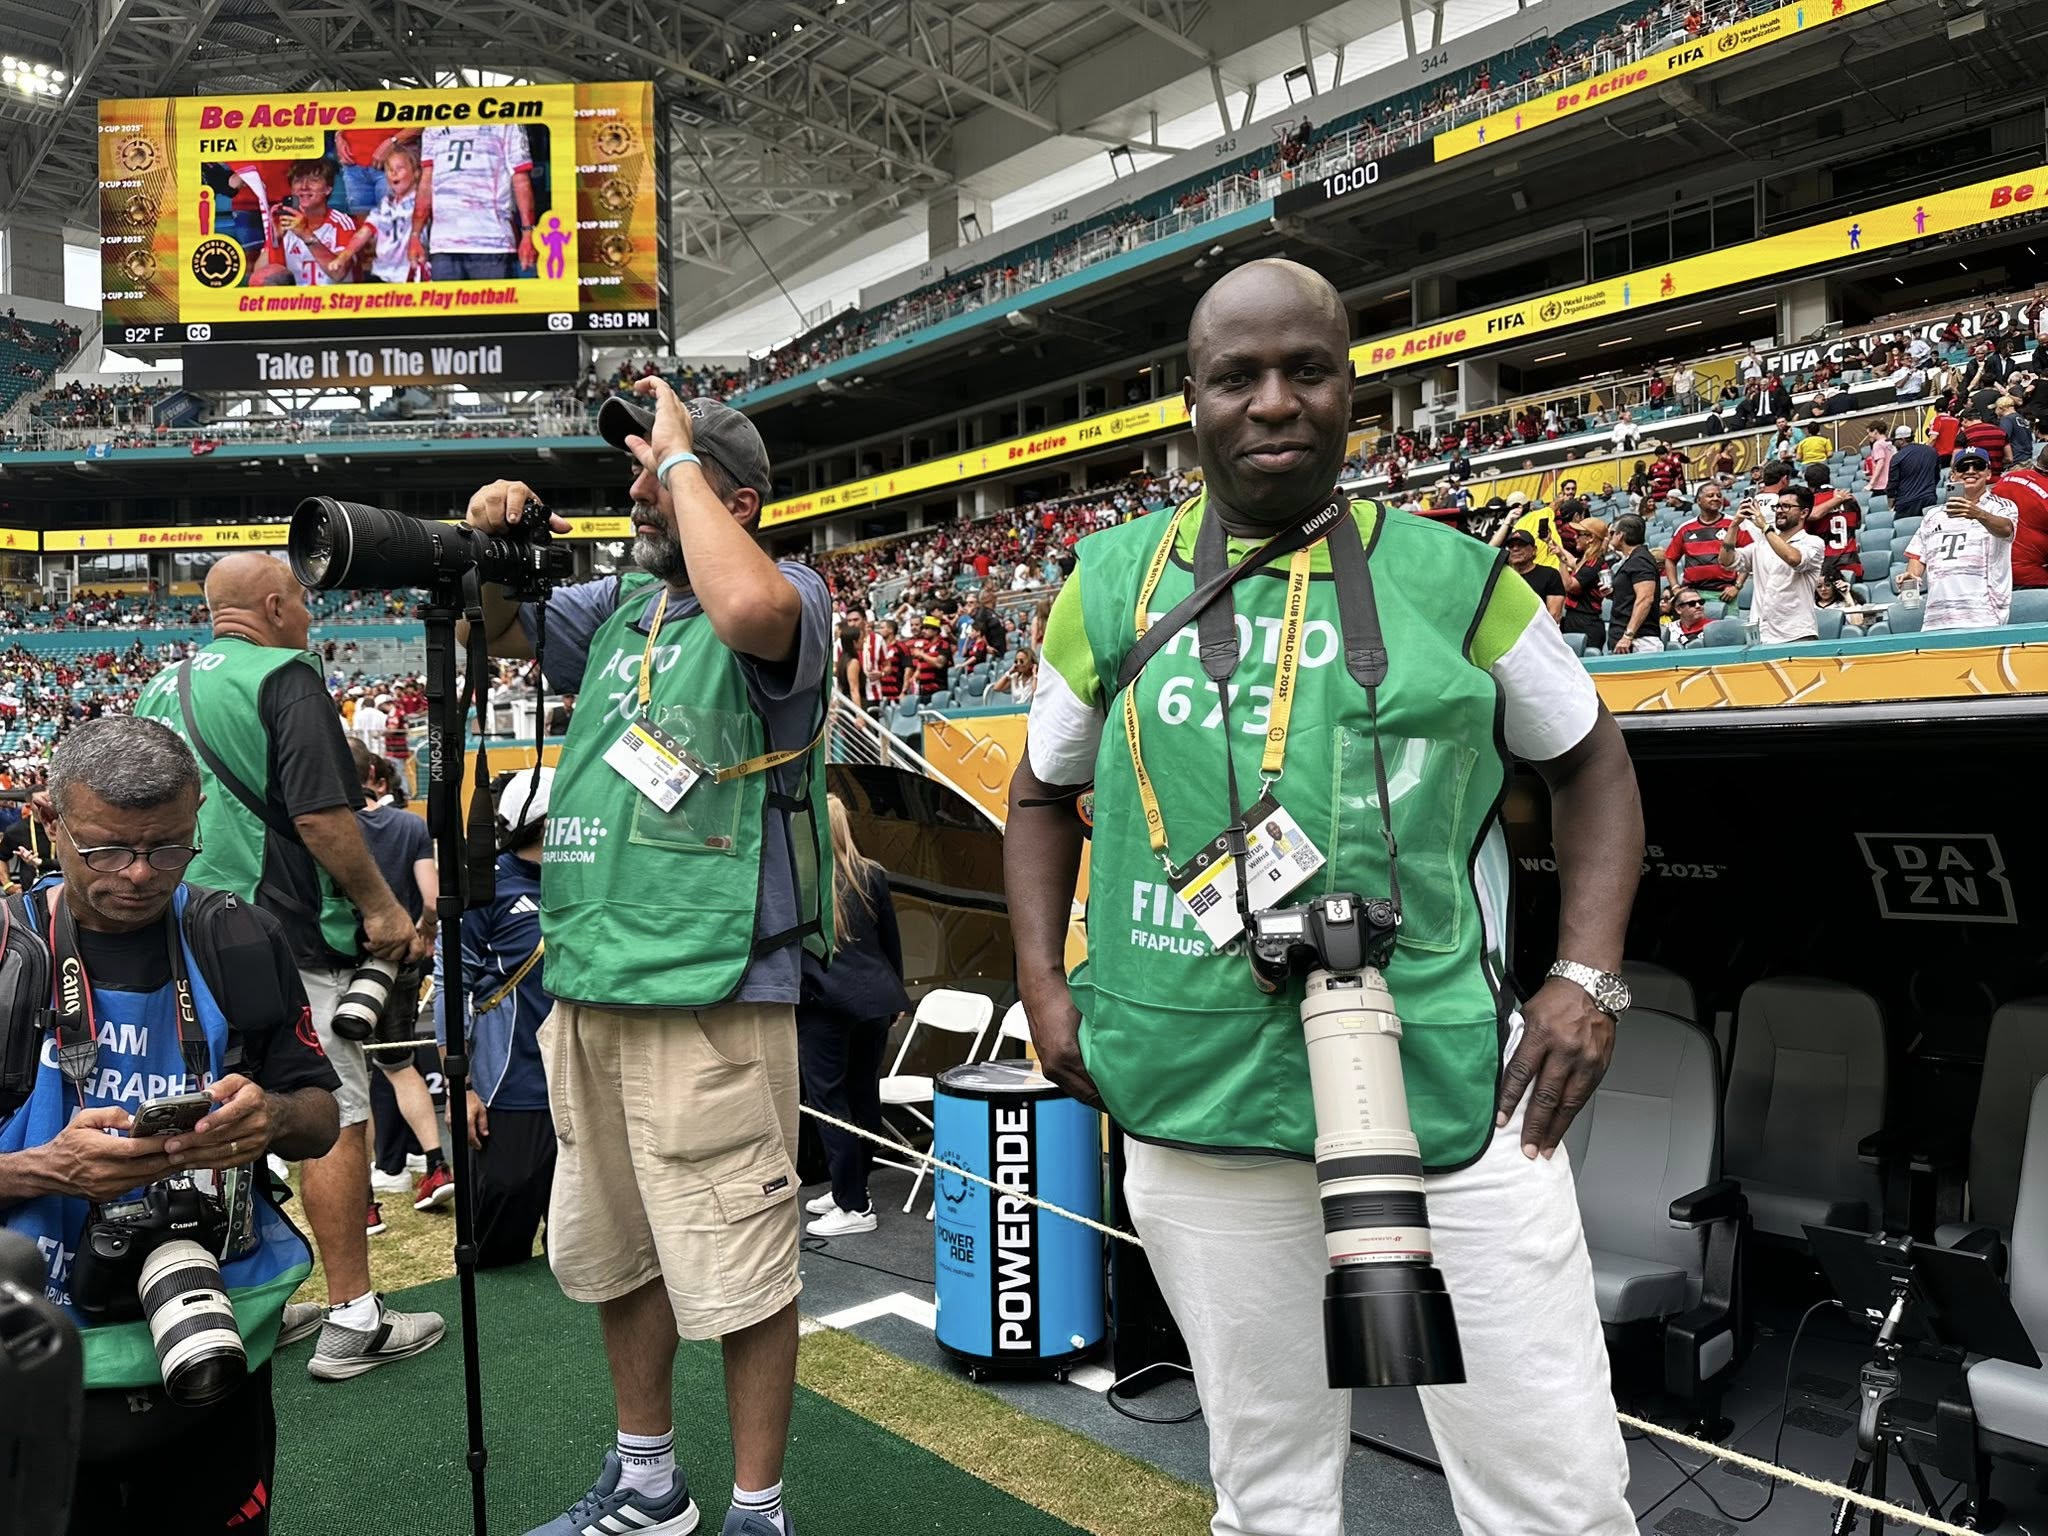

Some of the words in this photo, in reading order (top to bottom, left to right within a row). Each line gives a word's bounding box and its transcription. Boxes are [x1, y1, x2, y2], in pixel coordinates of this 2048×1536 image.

[1740, 24, 1757, 38] World
[1758, 18, 1780, 31] Health
[1740, 25, 1781, 44] Organization
[1421, 51, 1448, 73] 344
[1668, 47, 1704, 70] FIFA
[1556, 93, 1580, 111] Be
[1585, 69, 1648, 99] Active
[200, 105, 244, 130] Be
[248, 102, 356, 127] Active
[375, 98, 471, 122] Dance
[477, 97, 543, 119] Cam
[200, 138, 237, 154] FIFA
[1215, 139, 1237, 157] 343
[1323, 162, 1379, 198] 10:00
[1990, 184, 2034, 209] Be
[1051, 209, 1069, 224] 342
[107, 292, 123, 300] CUP
[239, 295, 262, 312] Get
[266, 293, 326, 313] moving.
[330, 292, 362, 313] Stay
[365, 289, 417, 308] active.
[419, 289, 451, 310] Play
[455, 286, 519, 305] football.
[1563, 298, 1580, 308] World
[1582, 290, 1606, 303] Health
[1563, 298, 1606, 316] Organization
[588, 315, 623, 329] 3:50
[628, 313, 650, 327] PM
[1487, 312, 1526, 334] FIFA
[154, 327, 164, 342] F
[1371, 347, 1396, 365] Be
[1402, 329, 1466, 356] Active
[257, 353, 313, 381] Take
[322, 351, 339, 378] It
[346, 350, 373, 377] To
[381, 347, 424, 376] The
[430, 346, 503, 375] World
[1767, 348, 1821, 376] FIFA
[119, 373, 141, 384] 337
[1079, 426, 1102, 440] FIFA
[1008, 447, 1024, 459] Be
[1027, 436, 1067, 454] Active
[784, 501, 812, 515] Active
[820, 495, 836, 506] FIFA
[1302, 503, 1339, 536] Canon
[138, 533, 156, 543] Be
[159, 532, 203, 543] Active
[216, 531, 240, 541] FIFA
[1829, 516, 1848, 550] 9
[1148, 568, 1159, 587] CLUB
[1154, 538, 1170, 567] WORLD
[1293, 573, 1303, 592] FIFA
[1290, 595, 1301, 617] CLUB
[1285, 619, 1298, 653] WORLD
[1283, 654, 1293, 673] CUP
[1157, 676, 1276, 735] 673
[1127, 707, 1136, 741] WORLD
[431, 722, 444, 782] KINGJOY
[1248, 851, 1270, 869] Wilfrid
[1893, 845, 1971, 872] DA
[1904, 875, 1979, 905] ZN
[1132, 880, 1204, 931] FIF
[62, 957, 81, 1017] Cano
[177, 979, 194, 1022] EOS
[97, 1020, 148, 1057] AM
[170, 1221, 198, 1230] Canon
[996, 1108, 1032, 1350] POWERADE
[937, 1225, 975, 1250] POWER
[950, 1246, 975, 1264] ADE
[620, 1455, 660, 1466] SPORTS
